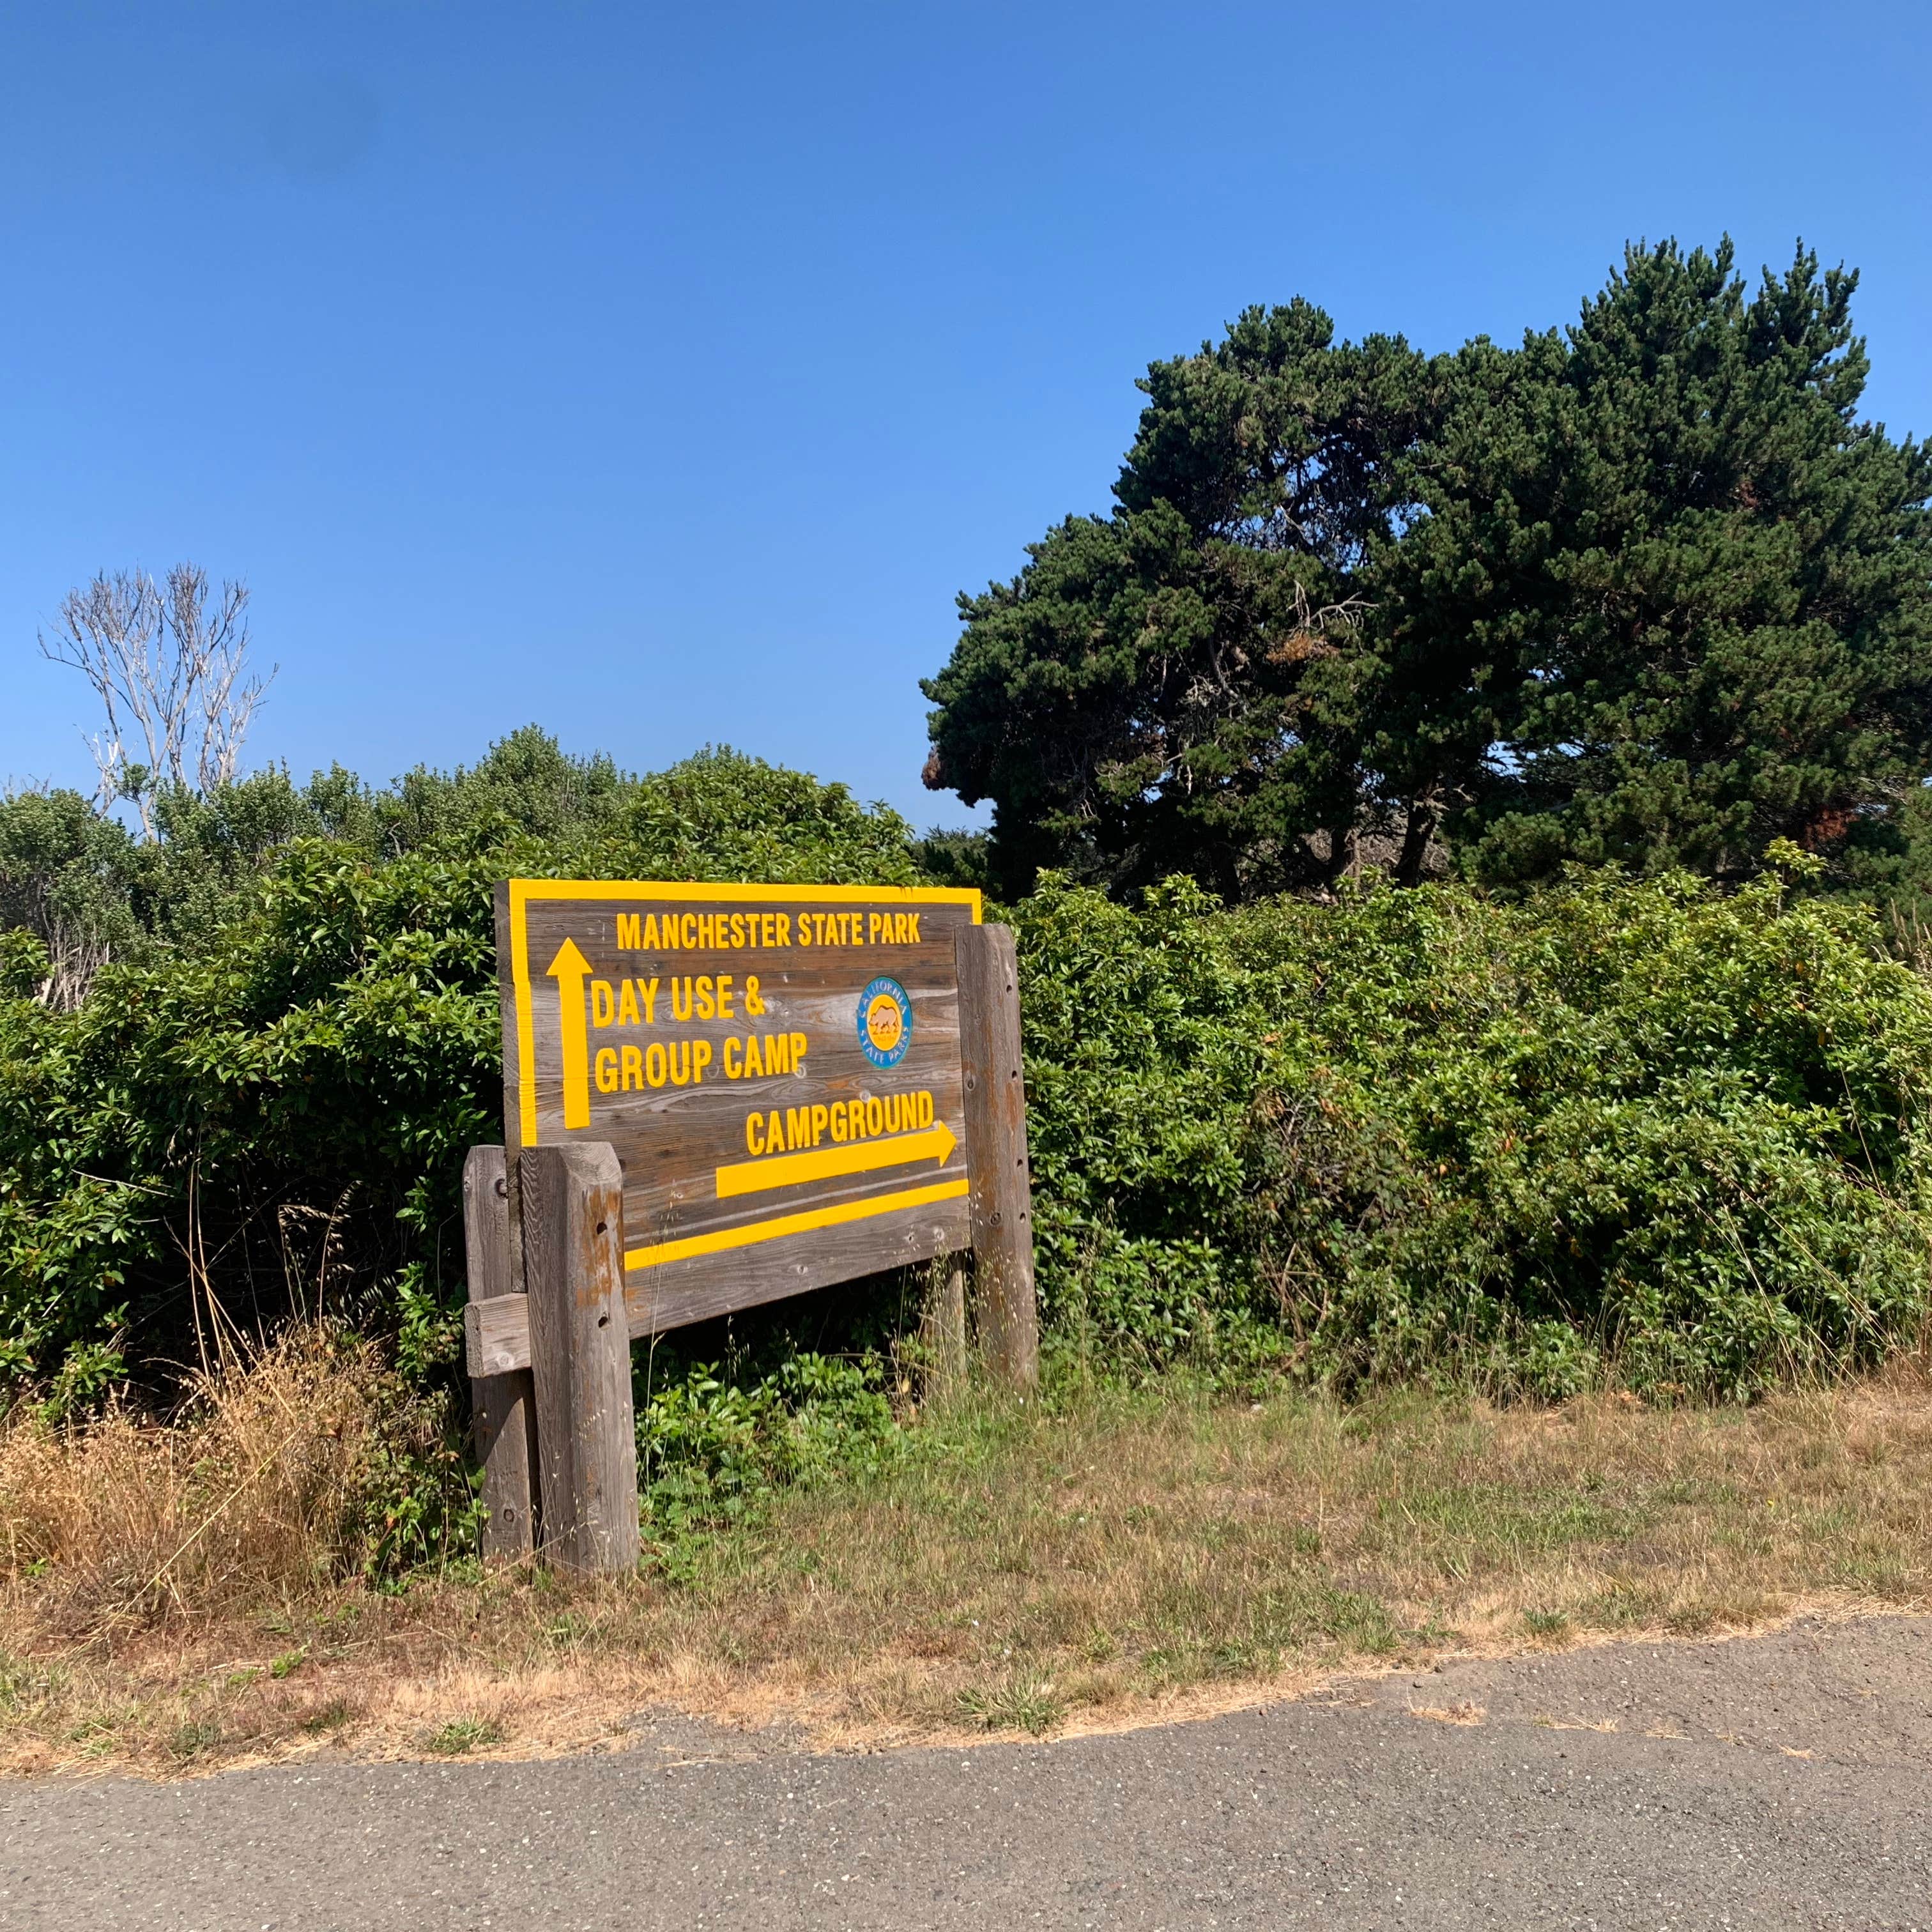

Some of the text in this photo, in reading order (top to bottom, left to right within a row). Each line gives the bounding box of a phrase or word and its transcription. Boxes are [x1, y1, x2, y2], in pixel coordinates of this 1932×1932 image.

[616, 912, 921, 950] MANCHESTER STATE PARK
[590, 975, 766, 1029] DAY USE &
[859, 980, 907, 1018] CALIFORNIA
[594, 1032, 808, 1093] GROUP CAMP
[746, 1091, 935, 1156] CAMPGROUND
